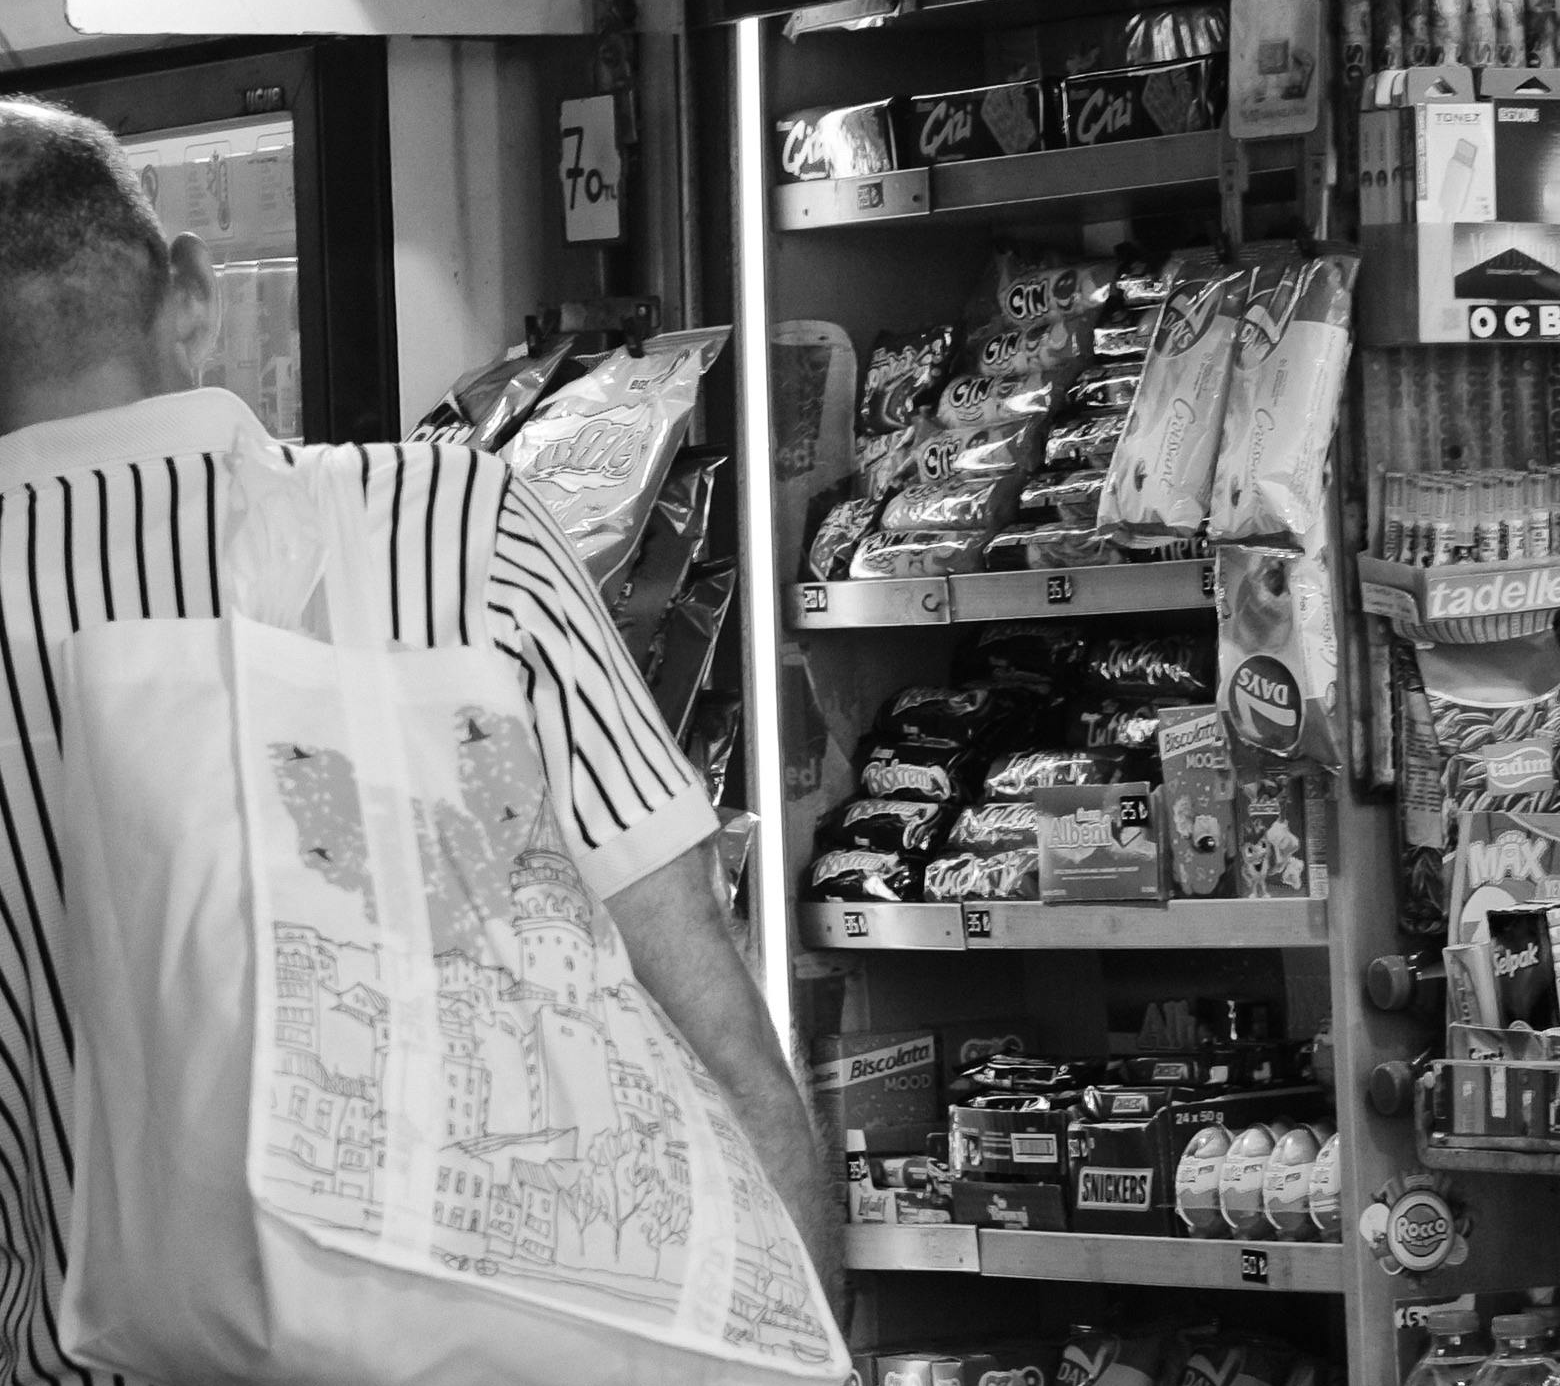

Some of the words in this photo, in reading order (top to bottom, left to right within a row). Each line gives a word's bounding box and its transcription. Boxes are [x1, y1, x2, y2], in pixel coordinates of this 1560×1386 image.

[1467, 836, 1545, 887] MAX
[849, 1043, 930, 1081] Biscolata
[883, 1074, 932, 1093] MOOD
[1082, 1172, 1148, 1205] SNICKERS
